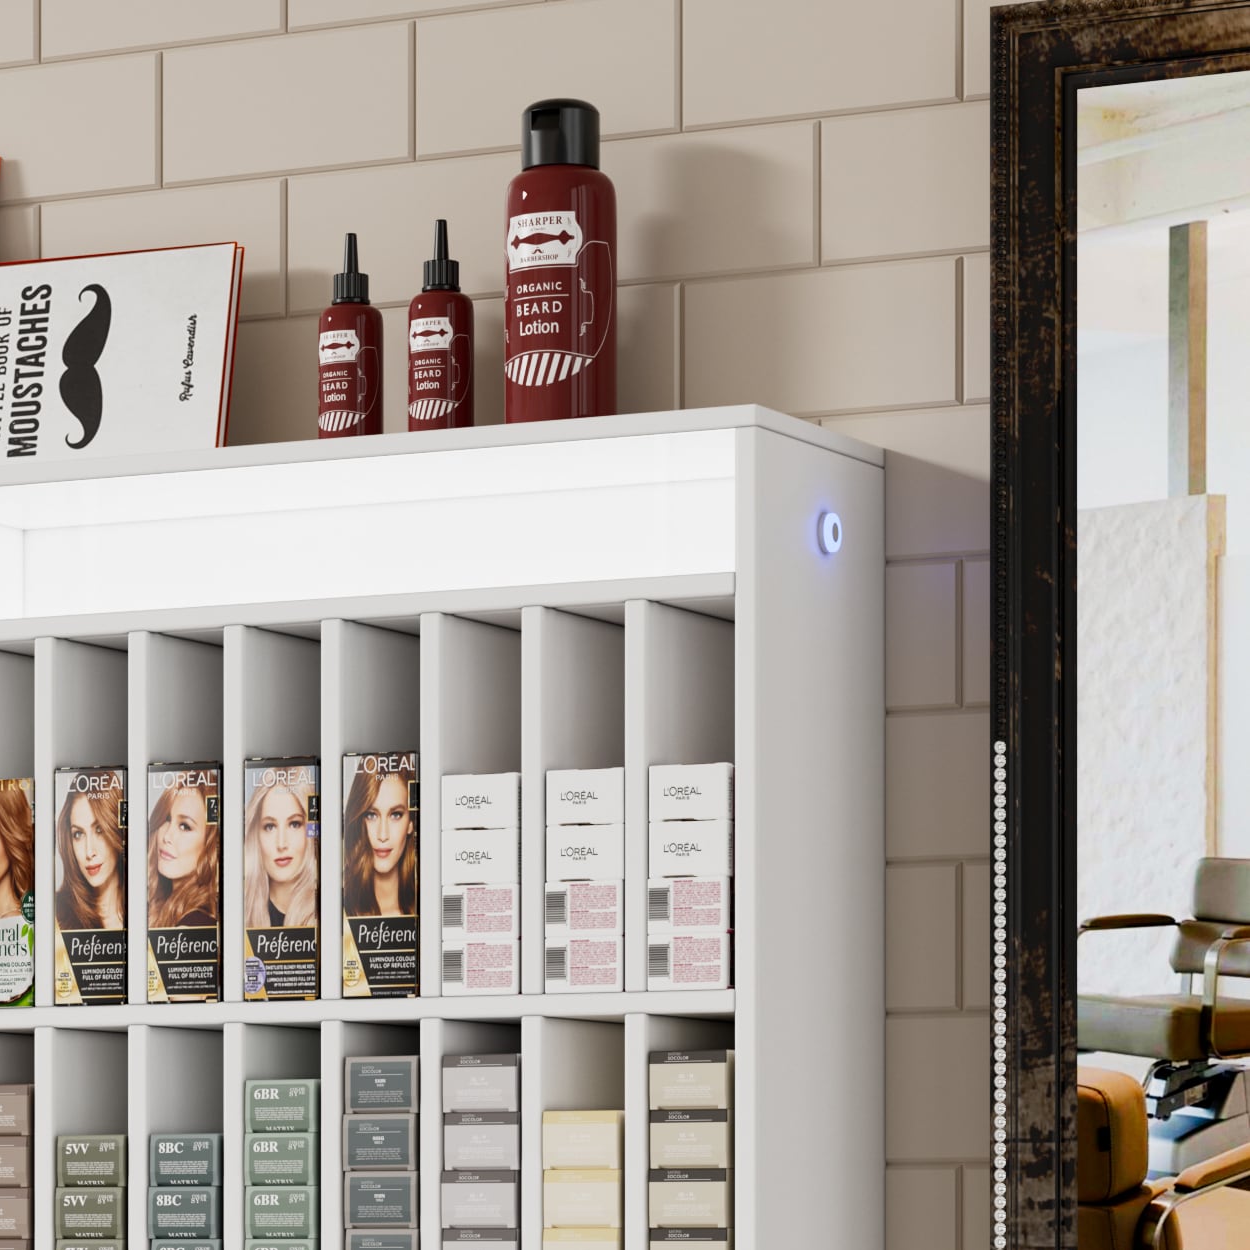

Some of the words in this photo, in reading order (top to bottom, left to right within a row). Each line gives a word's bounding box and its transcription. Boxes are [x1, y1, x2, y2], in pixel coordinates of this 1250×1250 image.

[517, 215, 563, 229] SHARPER
[520, 254, 559, 263] BARBERSHOP
[517, 282, 562, 294] ORGANIC
[516, 301, 562, 317] BEARD
[519, 319, 559, 336] Lotion
[183, 313, 197, 369] Cavendish
[415, 358, 441, 366] ORGANIC
[7, 284, 52, 458] MOUSTACHES
[323, 370, 348, 378] ORGANIC
[414, 369, 441, 379] BEARD
[179, 371, 193, 402] Rufus
[322, 381, 348, 392] BEARD
[416, 381, 440, 391] Lotion
[324, 392, 346, 403] Lotion
[355, 755, 415, 774] L'ORÉAL
[153, 770, 217, 789] L'ORÉAL
[253, 768, 316, 787] L'ORÉAL
[560, 790, 598, 802] L'ORÉAL
[663, 785, 702, 797] L'ORÉAL
[455, 794, 492, 806] L'ORÉAL
[560, 846, 598, 858] L'ORÉAL
[663, 842, 702, 853] L'ORÉAL
[455, 849, 492, 861] L'ORÉAL
[71, 934, 122, 962] Préféren
[157, 933, 217, 960] Préférenc
[257, 932, 316, 959] Préférenc
[253, 1088, 280, 1100] 6BR
[65, 1143, 90, 1155] 5VV
[158, 1142, 184, 1154] 8BC
[253, 1141, 279, 1153] 6BR
[63, 1195, 88, 1207] 5VV
[156, 1194, 182, 1207] 8BC
[253, 1194, 280, 1206] 6BR
